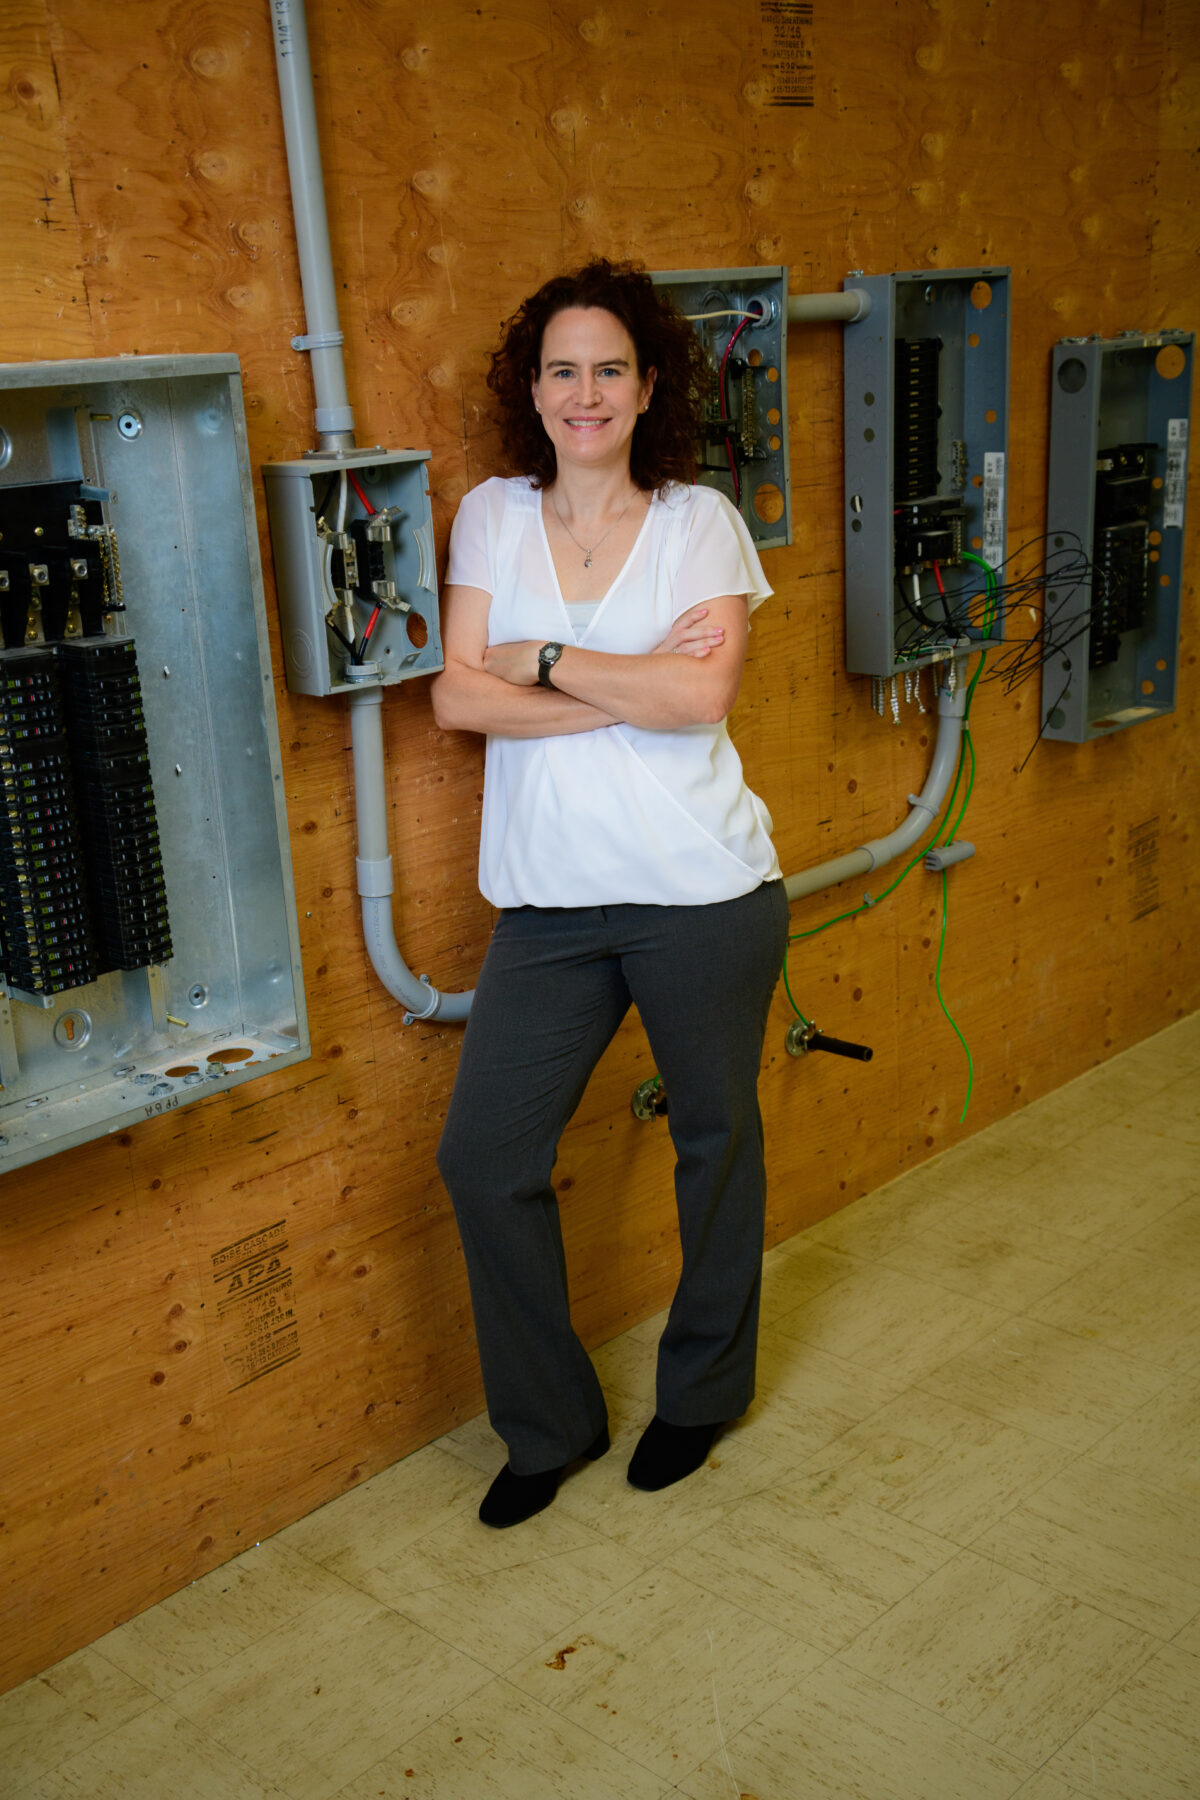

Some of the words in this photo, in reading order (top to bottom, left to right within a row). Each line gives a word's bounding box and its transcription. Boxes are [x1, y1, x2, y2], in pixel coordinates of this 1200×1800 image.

[212, 1246, 241, 1266] BOISE
[243, 1225, 286, 1251] CASCADE
[227, 1257, 281, 1294] APA
